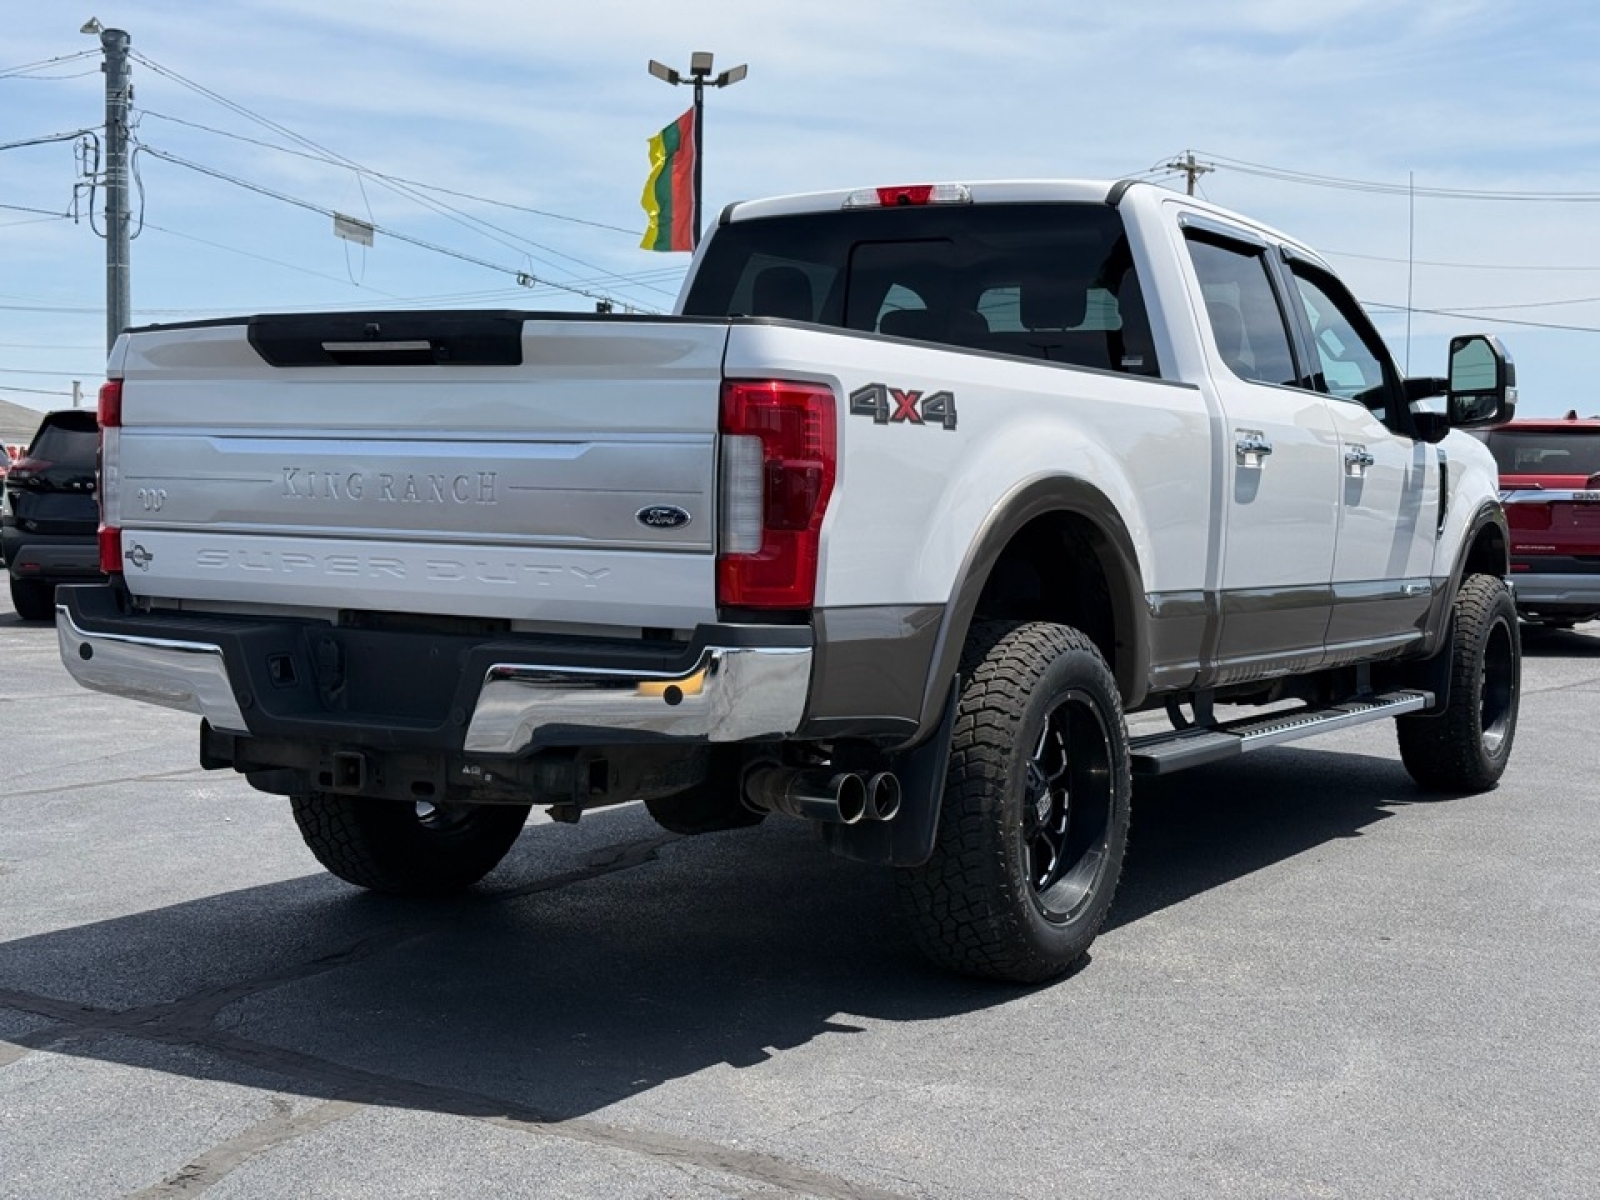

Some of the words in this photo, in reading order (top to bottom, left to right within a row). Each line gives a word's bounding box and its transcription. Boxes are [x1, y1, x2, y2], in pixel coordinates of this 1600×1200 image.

[282, 467, 364, 500] KING
[378, 472, 498, 505] RANCH
[197, 548, 406, 578] SUPER
[426, 559, 611, 588] DUTY
